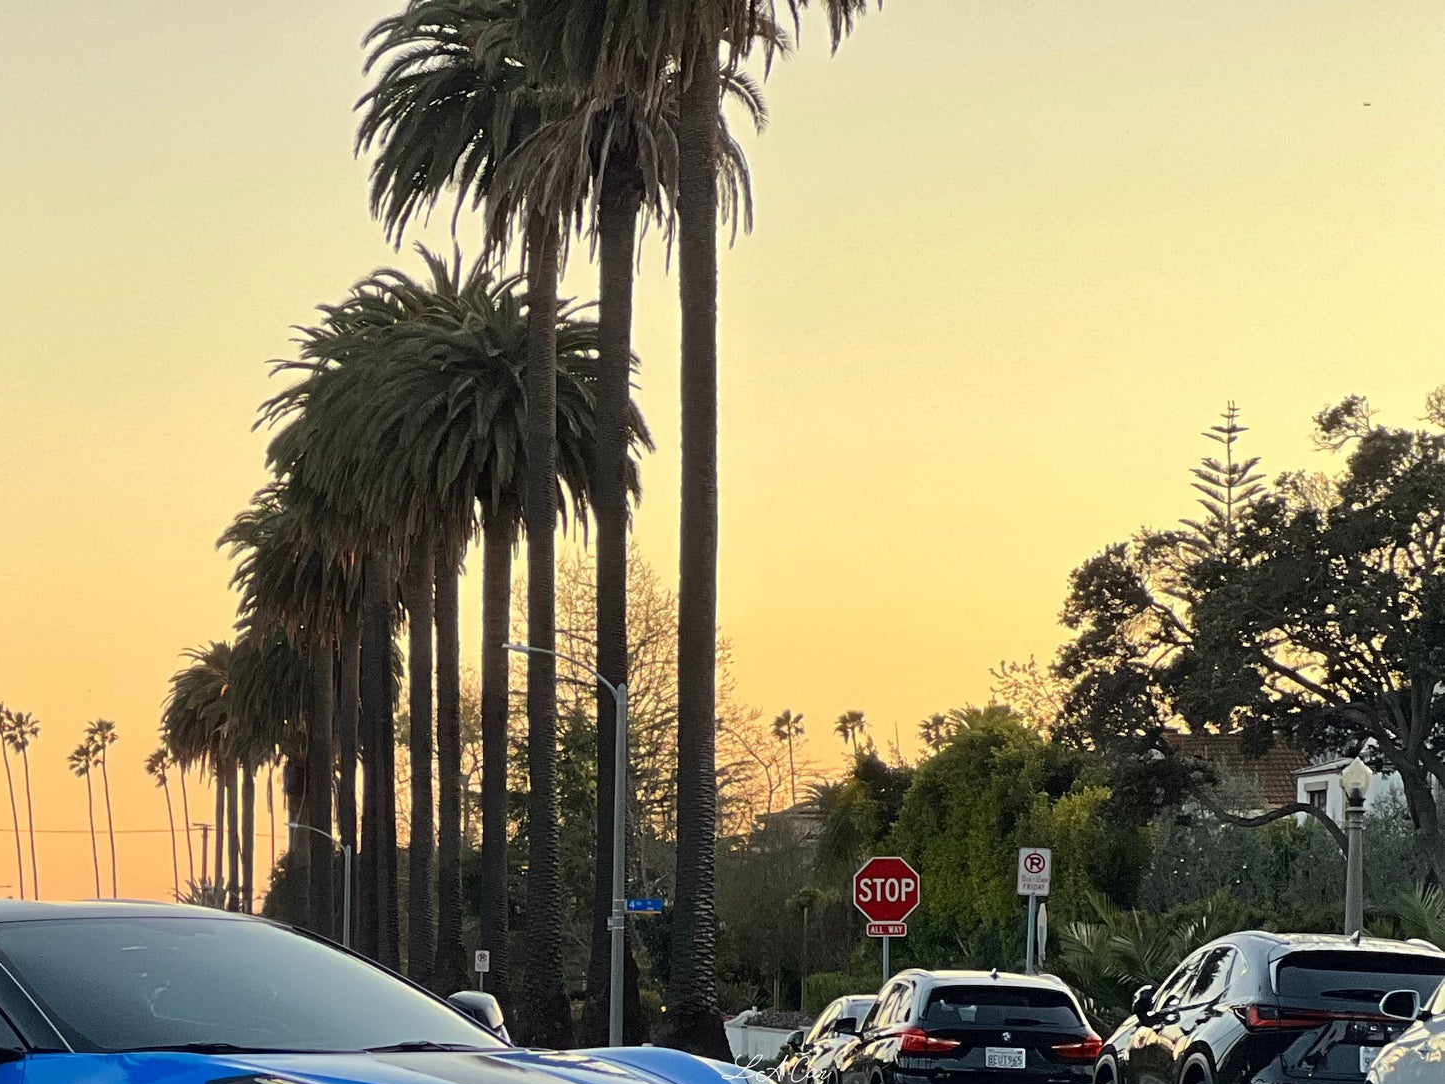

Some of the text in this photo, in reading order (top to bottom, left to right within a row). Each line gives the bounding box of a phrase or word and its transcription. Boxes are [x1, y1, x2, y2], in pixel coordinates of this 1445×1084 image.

[858, 877, 915, 903] STOP
[1022, 883, 1045, 891] FRIDAY
[869, 925, 904, 934] ALL WAY
